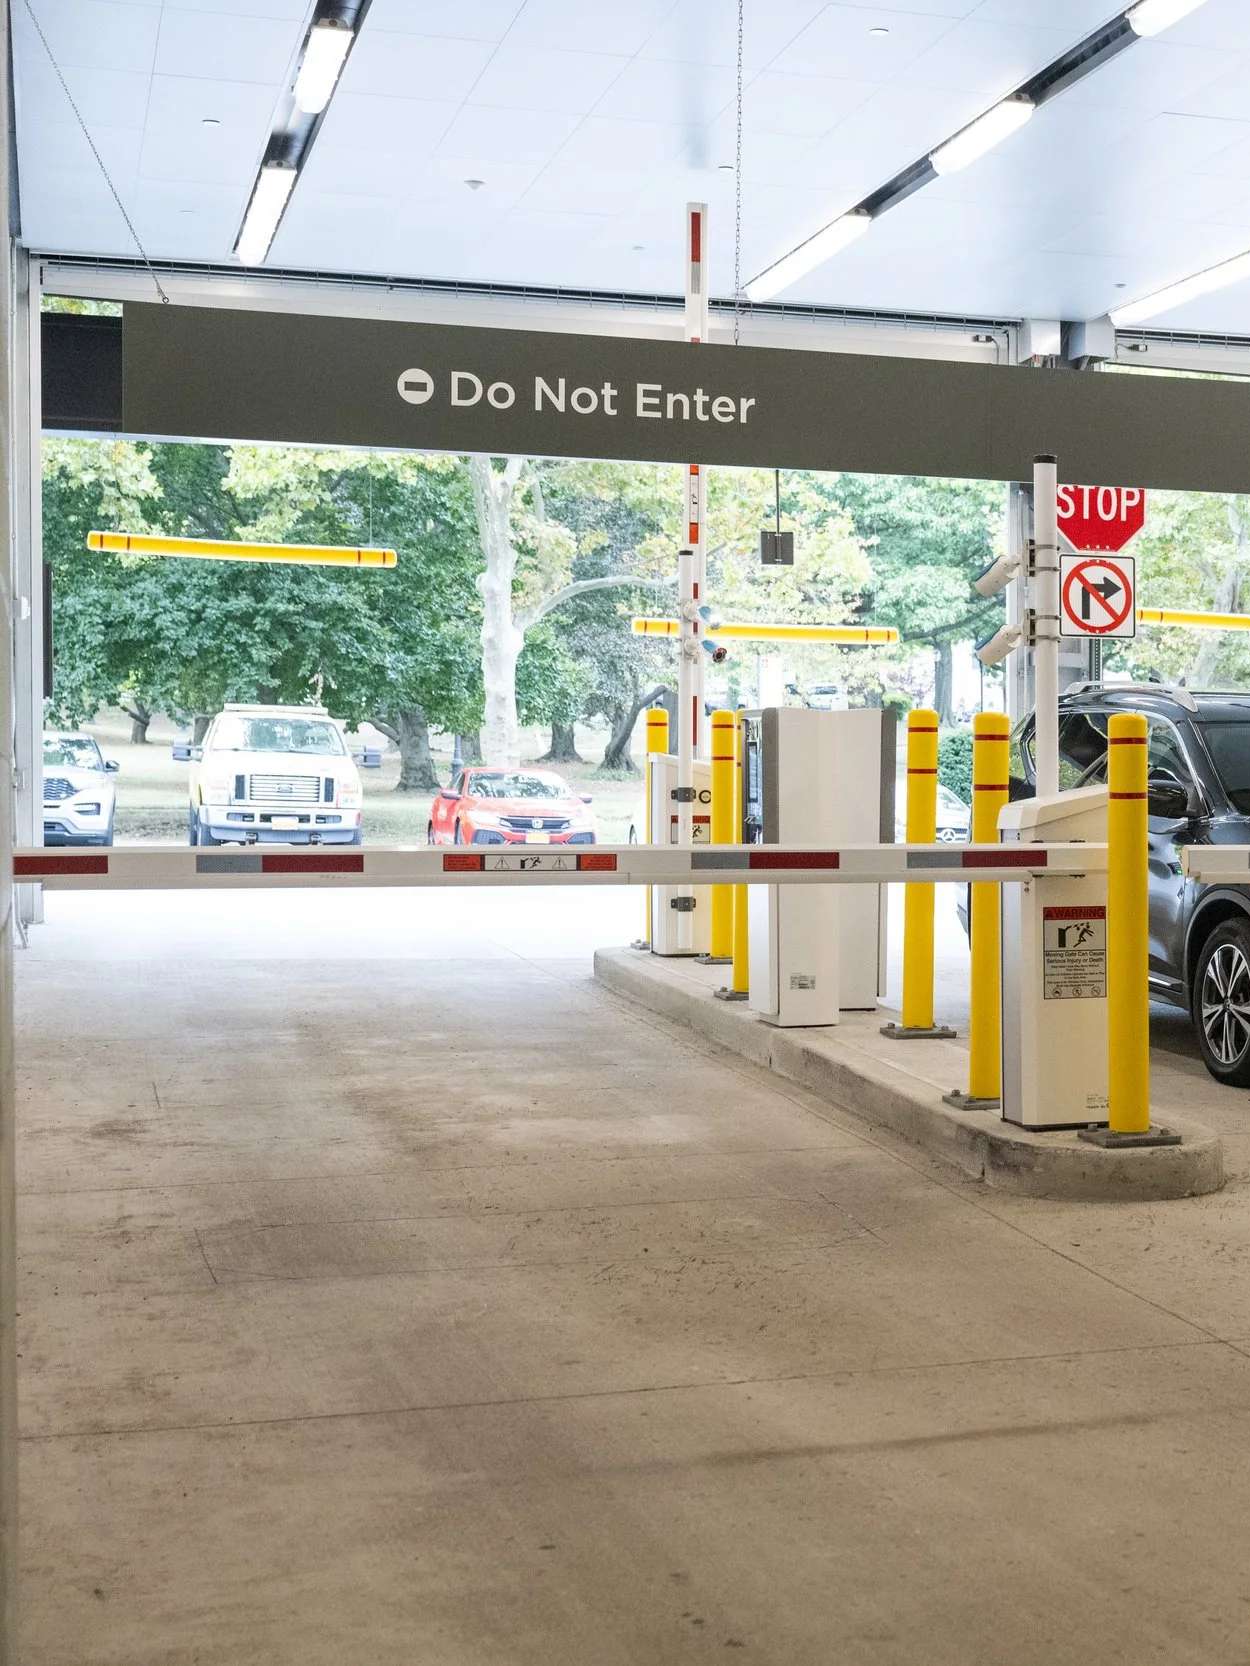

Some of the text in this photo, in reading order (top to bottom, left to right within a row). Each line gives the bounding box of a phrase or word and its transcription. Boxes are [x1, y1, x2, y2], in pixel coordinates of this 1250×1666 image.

[451, 371, 755, 424] Do Not Enter
[1057, 484, 1140, 521] STOP
[1056, 907, 1105, 918] WARNING
